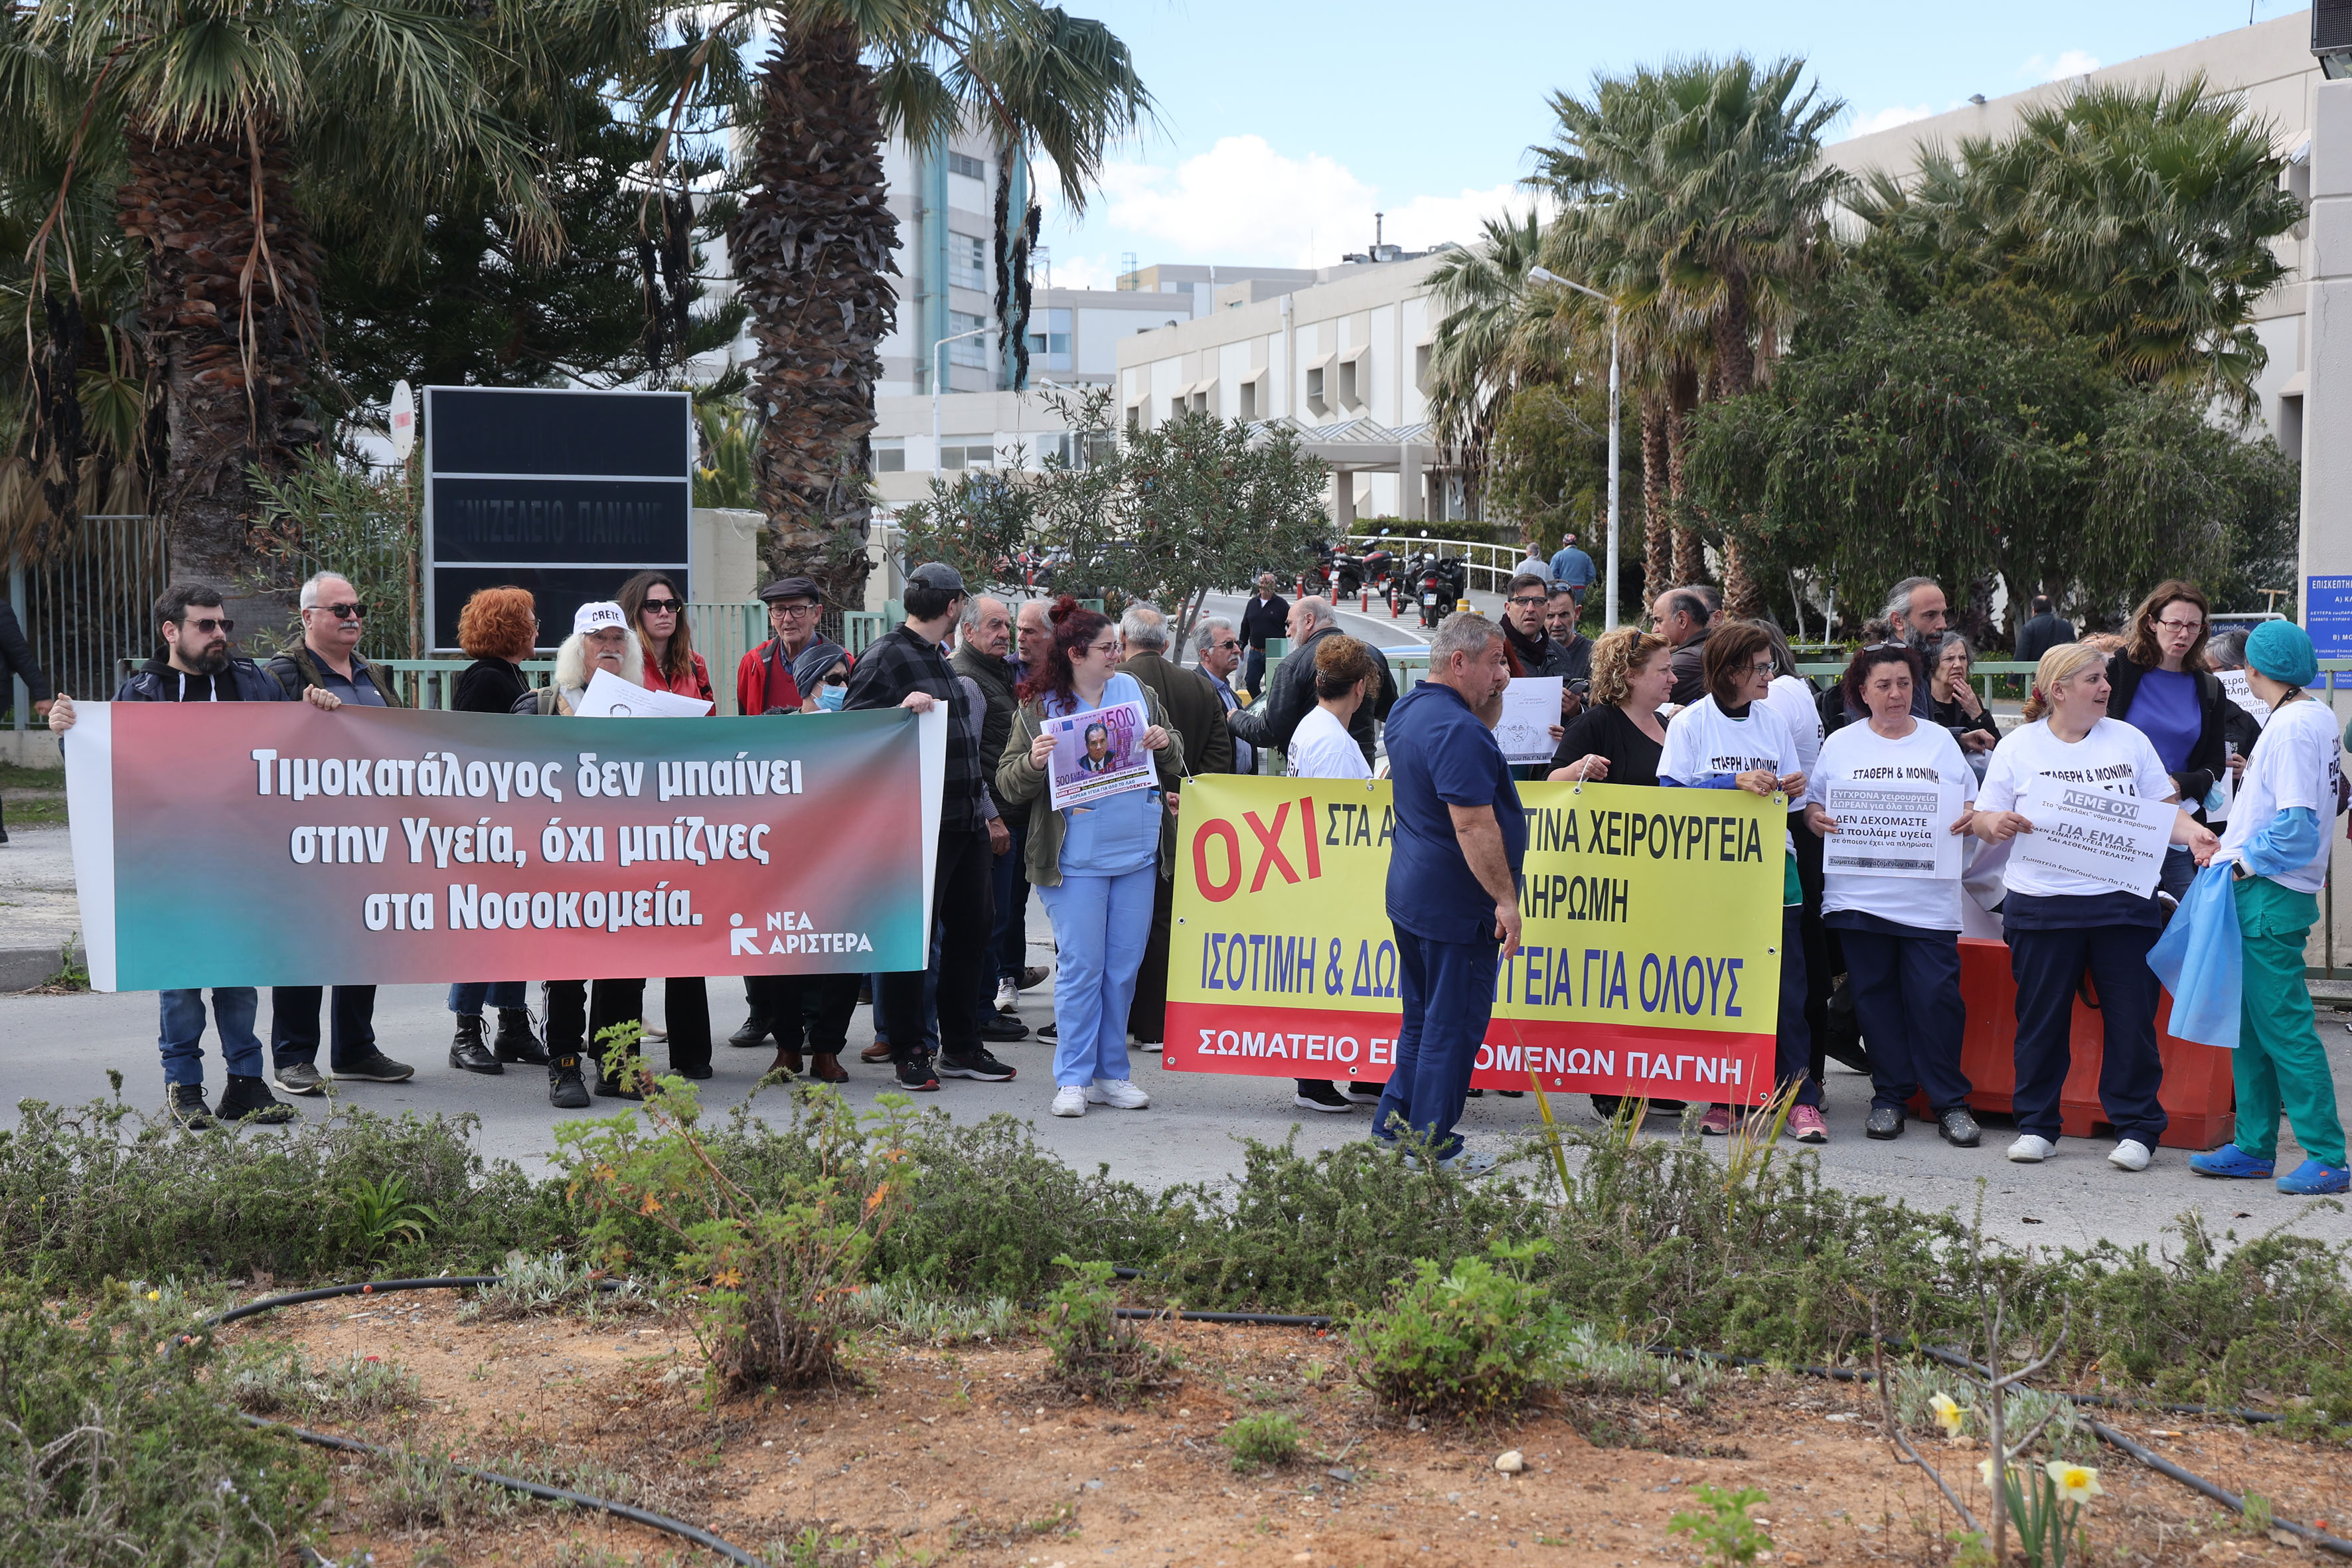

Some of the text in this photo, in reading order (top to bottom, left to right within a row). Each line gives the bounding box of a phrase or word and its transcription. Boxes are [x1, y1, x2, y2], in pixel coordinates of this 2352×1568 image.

[592, 610, 620, 622] CRETE
[1106, 707, 1136, 730] 500
[251, 749, 803, 803] Τιμοκατάλογος δεν μπαίνει
[1056, 774, 1070, 787] 500
[1070, 770, 1084, 779] EURO
[1853, 767, 1939, 784] ΣΤΑΘΕΡΗ & ΜΟΝΙΜΗ
[2086, 769, 2094, 782] &
[2094, 763, 2134, 781] ΜΟΝΙΜΗ
[1832, 791, 1936, 803] ΣΥΓΧΡΟΝΑ χειρουργεία
[1832, 801, 1868, 809] ΔΩΡΕΑΝ
[1869, 803, 1884, 811] για
[2063, 791, 2138, 818] ΛΕΜΕ ΟΧΙ
[1836, 815, 1927, 826] ΔΕΝ ΔΕΧΟΜΑΣΤΕ
[2093, 813, 2116, 823] νόμιμο
[2124, 819, 2157, 831] παράνομο
[289, 816, 771, 869] στην Υγεία, όχι μπίζνες
[1326, 803, 1371, 846] ΣΤΑ
[1587, 809, 1763, 862] ΧΕΙΡΟΥΡΓΕΙΑ
[1842, 838, 1867, 846] όποιον
[1847, 828, 1897, 838] πουλάμε
[1900, 829, 1932, 840] υγεία
[2058, 823, 2136, 848] ΓΙΑ ΕΜΑΣ
[1192, 796, 1322, 902] ΟΧΙ
[2051, 830, 2071, 839] ΕΙΝΑΙ
[2082, 836, 2102, 847] ΥΓΕΙΑ
[2104, 843, 2154, 859] ΕΜΠΟΡΕΥΜΑ
[2062, 840, 2098, 854] ΑΣΘΕΝΗΣ
[2099, 850, 2135, 862] ΠΕΛΑΤΗΣ
[364, 882, 702, 933] στα Νοσοκομεία.
[1518, 874, 1628, 923] ΛΗΡΩΜΗ
[767, 911, 813, 931] ΝΕΑ
[769, 933, 874, 955] ΑΡΙΣΤΕΡΑ
[1202, 933, 1316, 994] ΙΣΟΤΙΜΗ
[1325, 937, 1344, 996] &
[1350, 939, 1402, 998] ΔΩ
[1582, 949, 1628, 1010] ΓΙΑ
[1639, 953, 1743, 1017] ΟΛΟΥΣ
[1198, 1029, 1359, 1062] ΣΩΜΑΤΕΙΟ
[1626, 1051, 1742, 1085] ΠΑΓΝΗ
